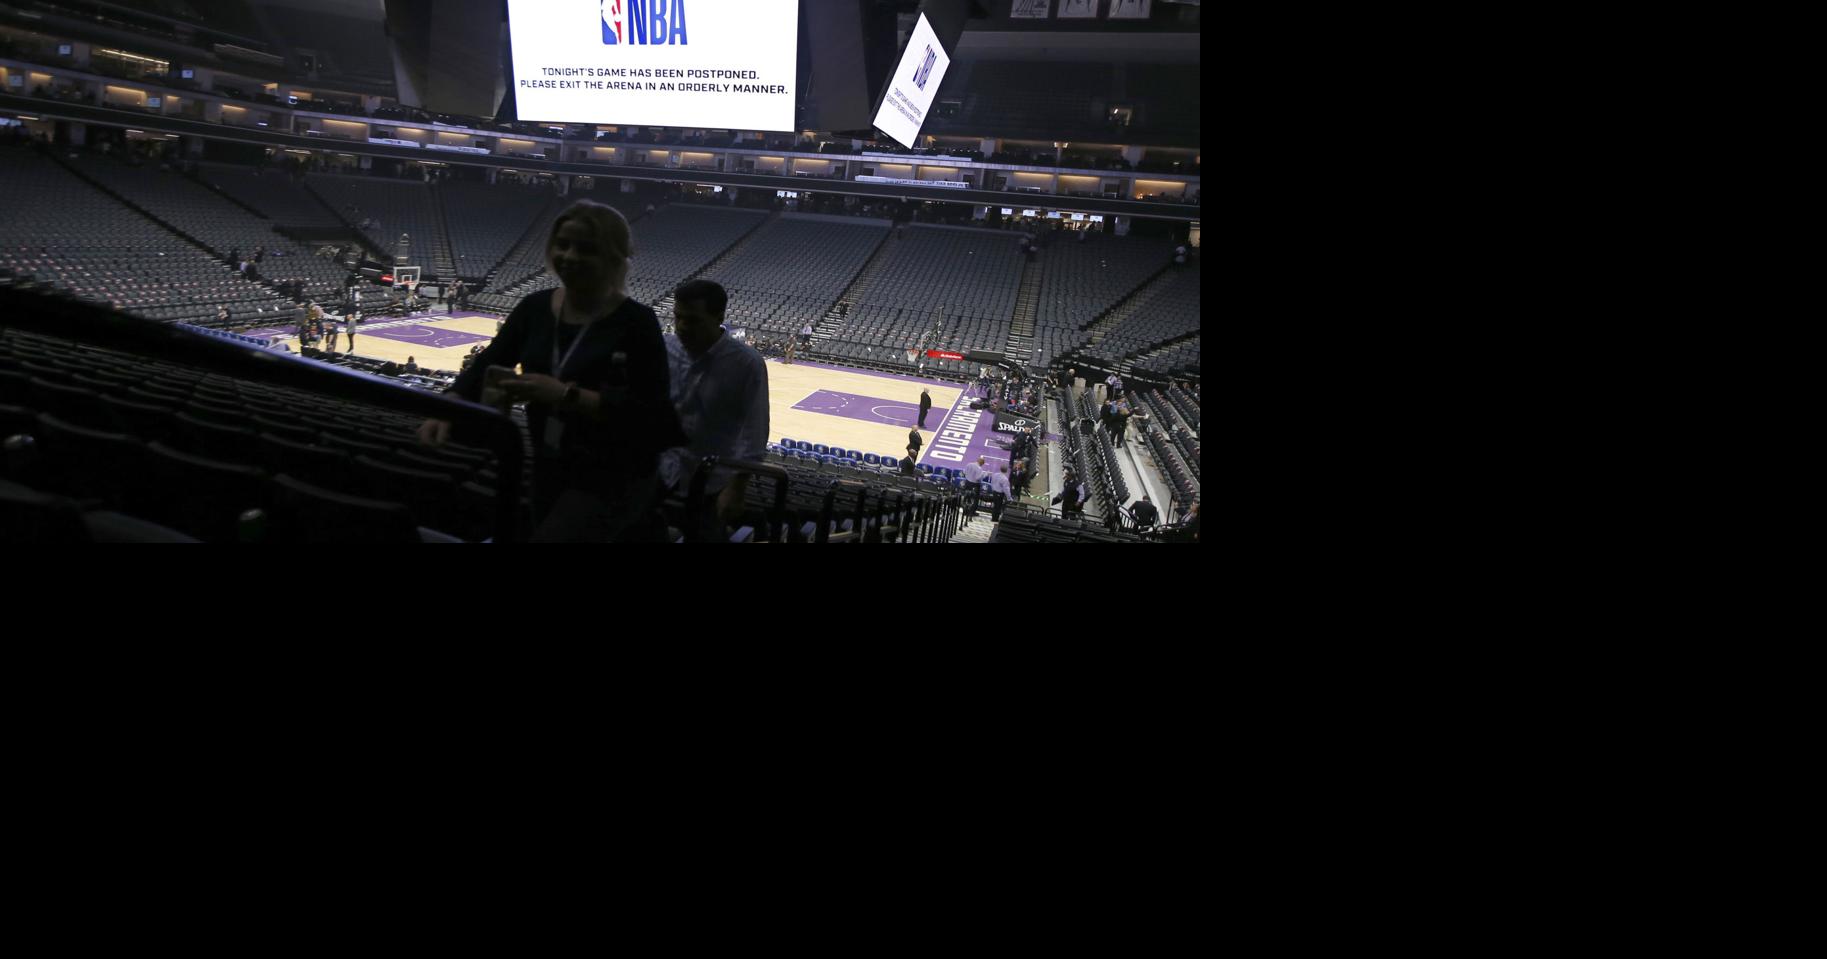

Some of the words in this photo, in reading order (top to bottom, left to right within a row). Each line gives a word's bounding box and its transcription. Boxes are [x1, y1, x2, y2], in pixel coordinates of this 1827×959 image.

[628, 0, 688, 45] NBA
[542, 67, 594, 77] TONIGHT'S
[597, 68, 627, 77] GAME
[629, 68, 652, 78] HAS
[655, 69, 684, 78] BEEN
[687, 69, 760, 80] POSTPONED.
[520, 79, 557, 89] PLEASE
[560, 80, 581, 89] EXIT
[583, 80, 604, 90] THE
[606, 81, 642, 91] ARENA
[645, 82, 656, 91] IN
[659, 82, 675, 91] AN
[678, 83, 730, 93] ORDERLY
[733, 84, 788, 94] MANNER.
